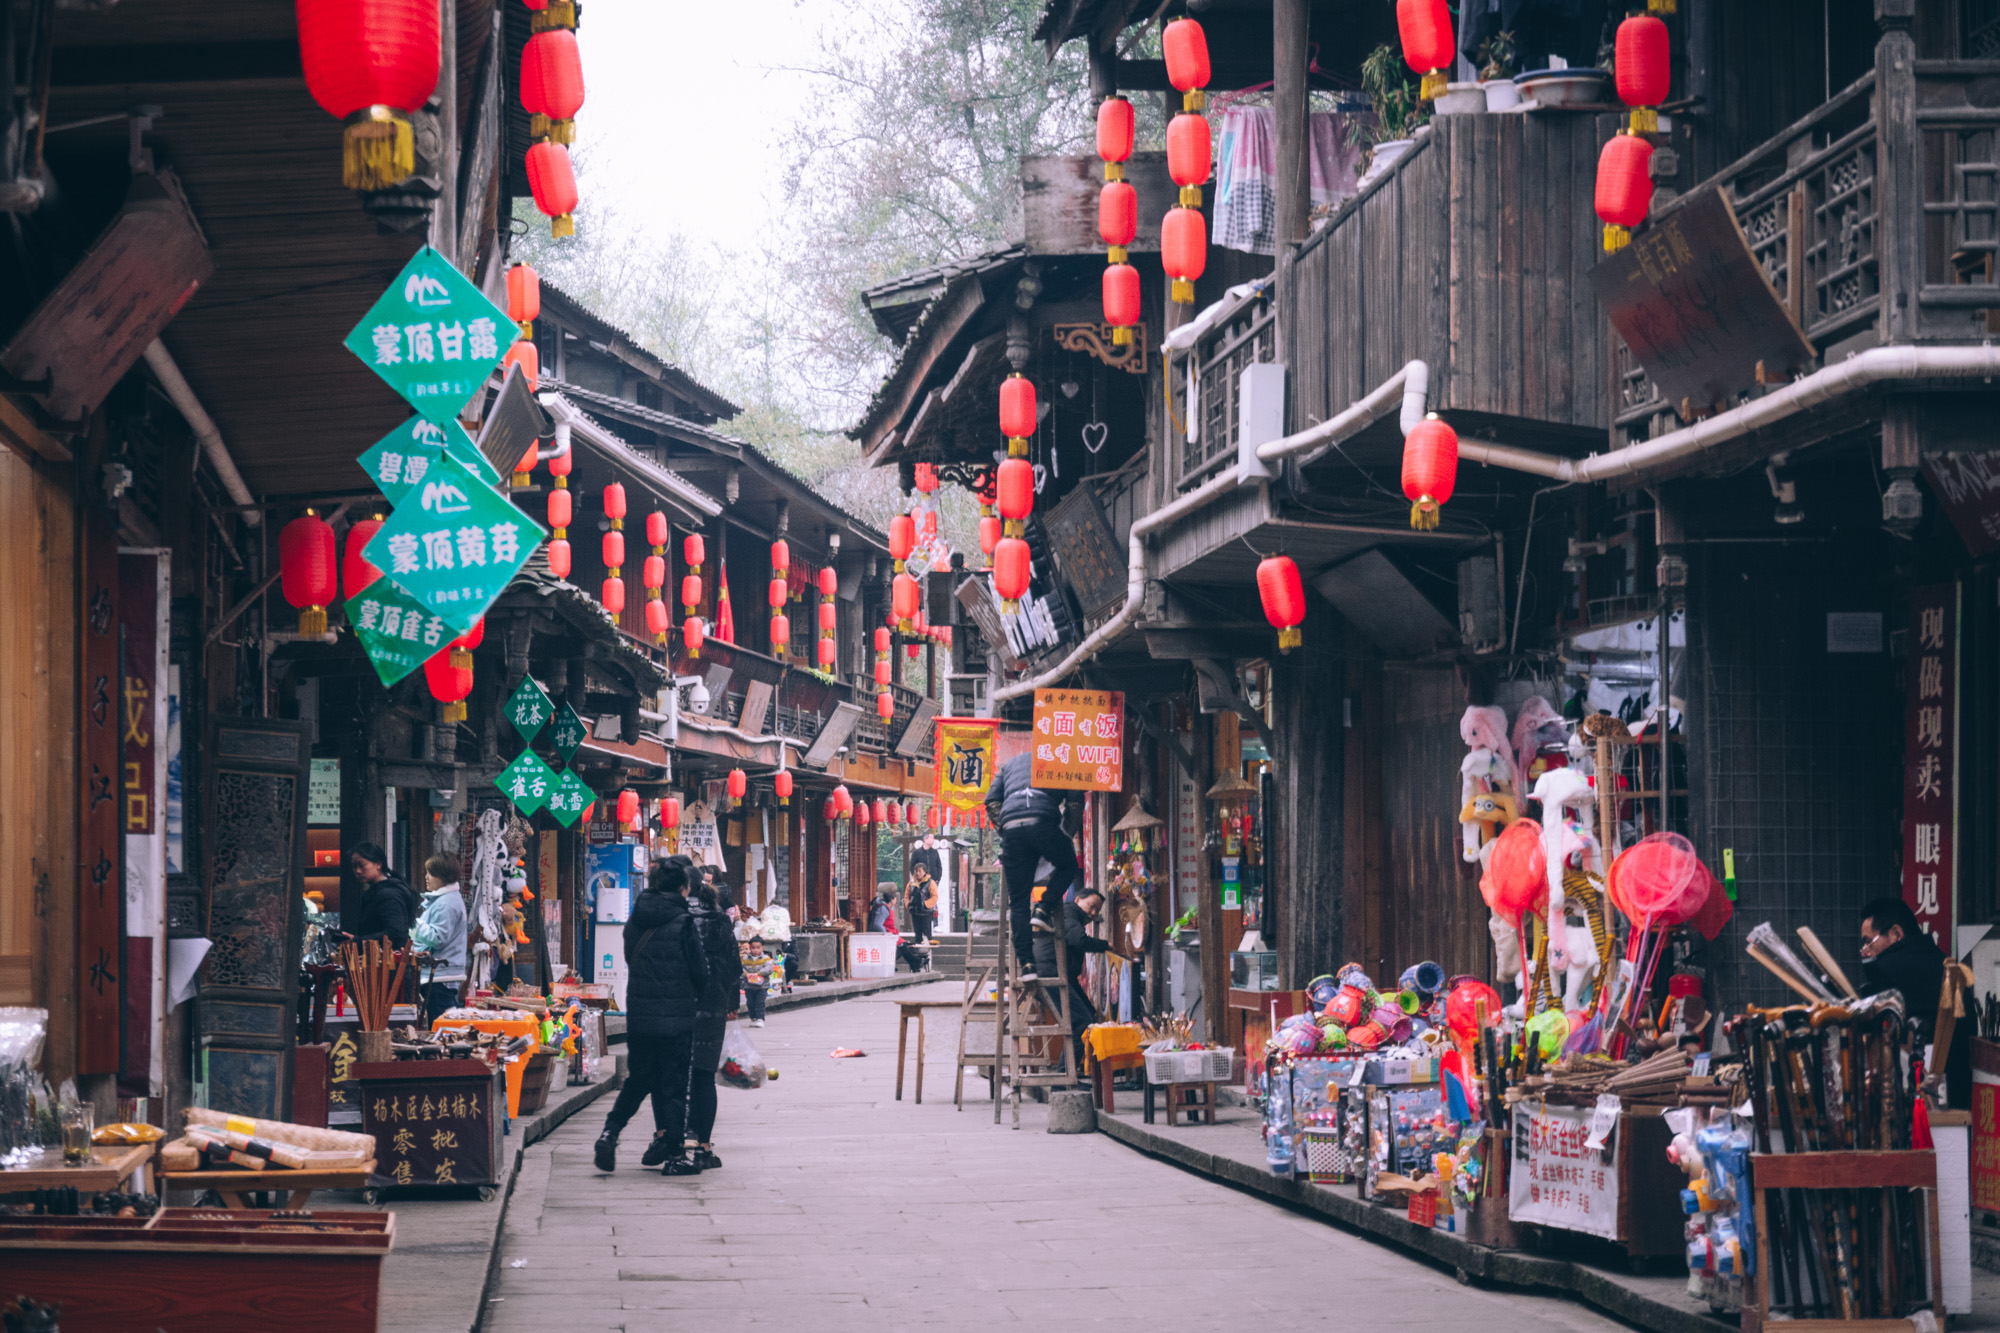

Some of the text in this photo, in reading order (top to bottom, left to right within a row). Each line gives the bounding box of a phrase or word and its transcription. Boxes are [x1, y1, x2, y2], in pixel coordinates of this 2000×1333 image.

[372, 317, 498, 366] 蒙顶甘露
[387, 521, 521, 575] 蒙顶黄芽
[358, 600, 444, 647] 蒙顶雀舌
[514, 702, 544, 726] 花茶
[1916, 606, 1945, 802] 现做现卖
[555, 726, 578, 748] 甘露
[946, 742, 983, 788] 酒
[1077, 745, 1120, 765] WIFI
[508, 774, 547, 800] 雀舌
[550, 791, 584, 812] 飘雪
[682, 837, 713, 847] 大甩卖
[856, 948, 881, 963] 雅鱼
[330, 1032, 358, 1084] 金
[373, 1092, 482, 1123] 杨木匠金丝楠木
[1979, 1087, 1996, 1133] 现
